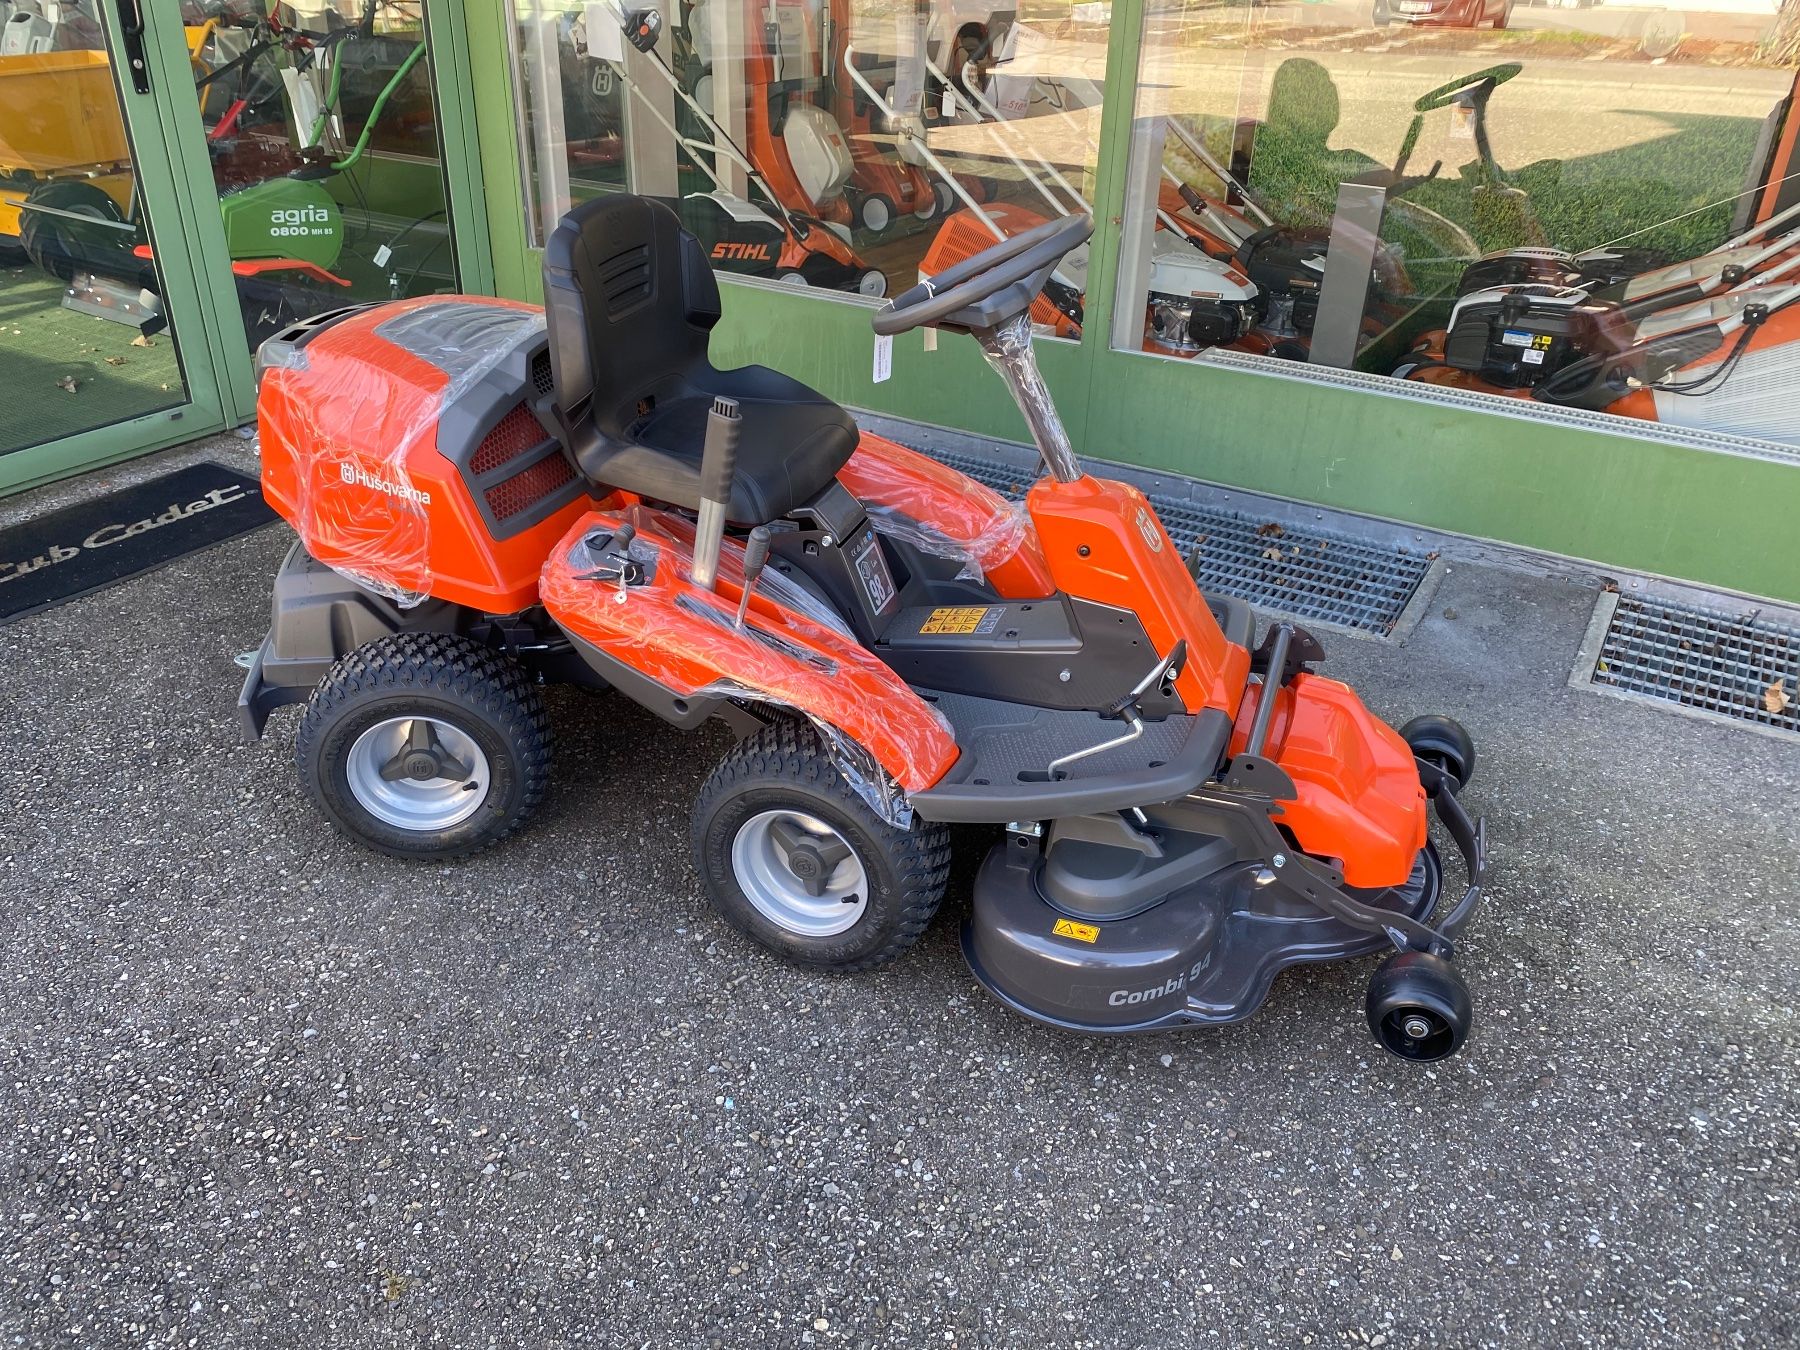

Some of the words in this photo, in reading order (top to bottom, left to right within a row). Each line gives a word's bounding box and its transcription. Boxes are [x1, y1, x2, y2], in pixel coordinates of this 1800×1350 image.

[271, 204, 329, 225] agria
[270, 226, 309, 236] 0800
[324, 227, 333, 235] 85
[710, 242, 771, 260] STIHL
[355, 468, 431, 505] Husqvarna
[83, 484, 246, 549] Cadet
[869, 574, 886, 606] 98
[1108, 972, 1185, 1006] Combi
[1189, 951, 1211, 982] 94
